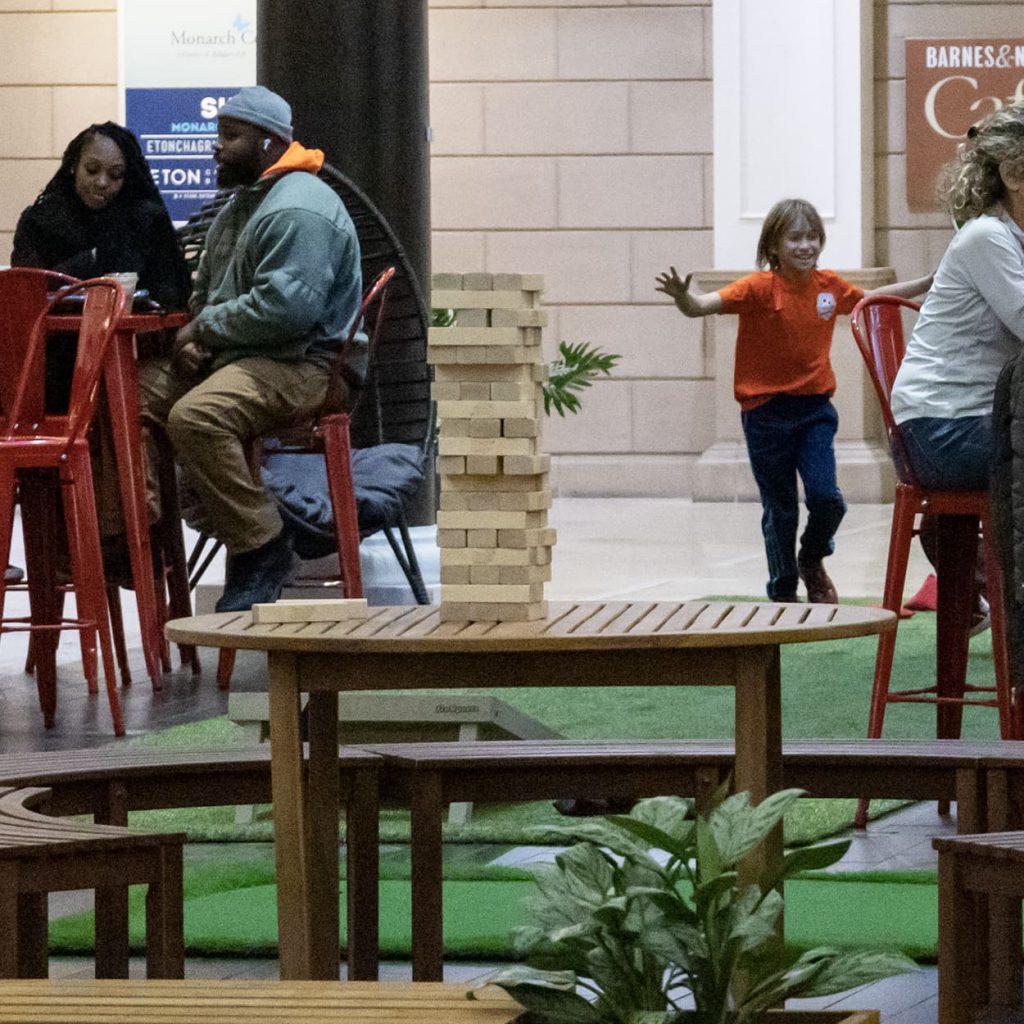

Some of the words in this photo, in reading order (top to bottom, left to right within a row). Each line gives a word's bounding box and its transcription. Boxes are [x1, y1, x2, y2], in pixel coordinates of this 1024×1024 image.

[170, 30, 236, 45] Monarch
[171, 121, 218, 133] MONAR
[146, 139, 216, 153] ETONCHAGR
